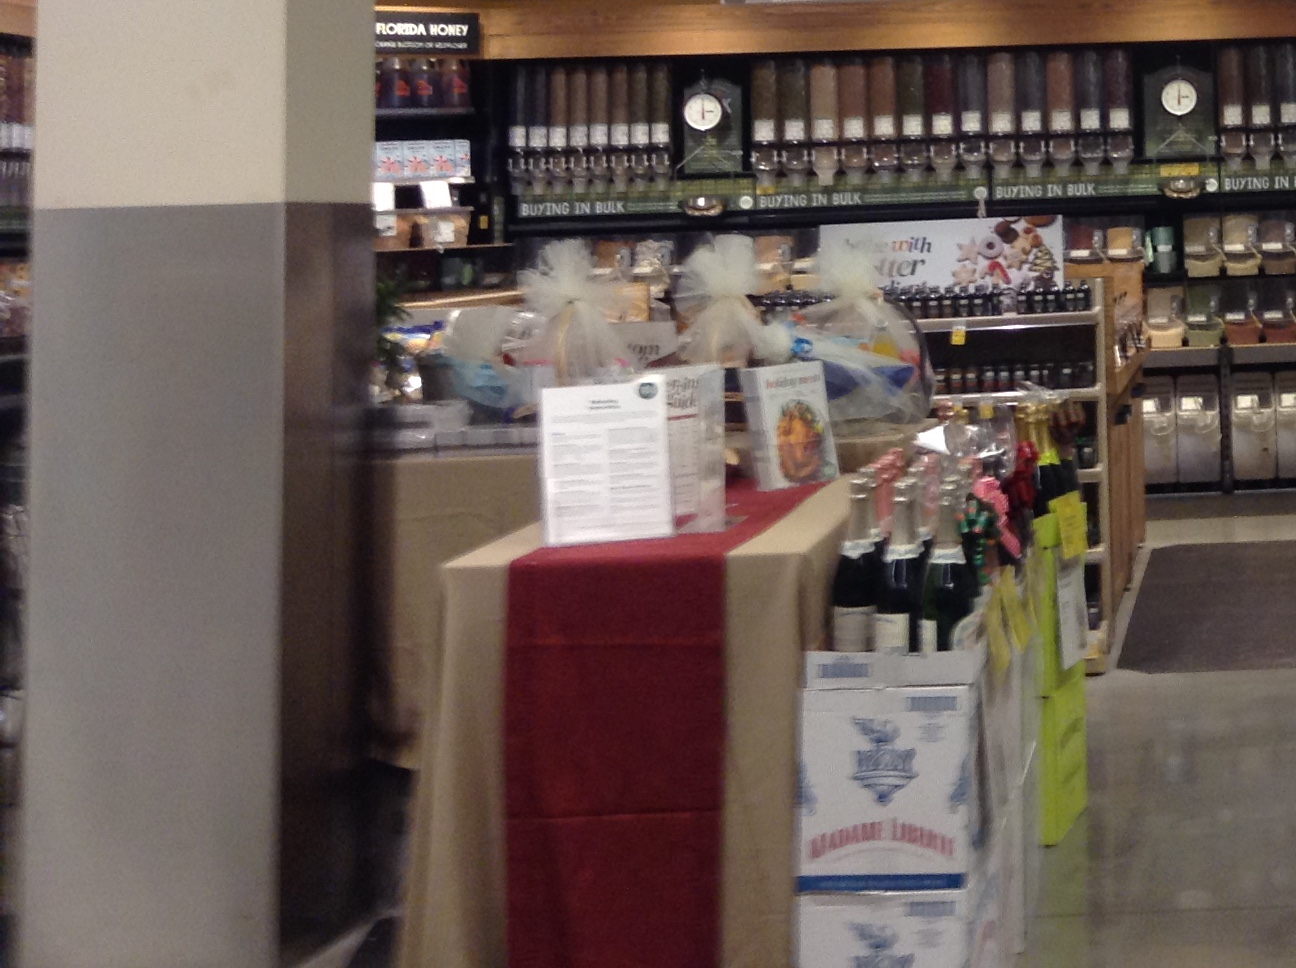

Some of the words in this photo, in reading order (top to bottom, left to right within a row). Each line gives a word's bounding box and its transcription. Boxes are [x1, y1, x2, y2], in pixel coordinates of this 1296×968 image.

[374, 22, 428, 36] FLORIDA
[430, 23, 469, 37] HONEY
[996, 184, 1043, 199] BUYING
[1047, 184, 1063, 197] IN
[1067, 183, 1097, 196] BULK
[1225, 177, 1270, 190] BUYING
[1274, 176, 1290, 189] IN
[760, 194, 807, 208] BUYING
[812, 194, 828, 207] IN
[832, 192, 863, 206] BULK
[521, 201, 570, 217] BUYING
[574, 201, 592, 215] IN
[596, 200, 626, 215] BULK
[892, 236, 933, 254] with
